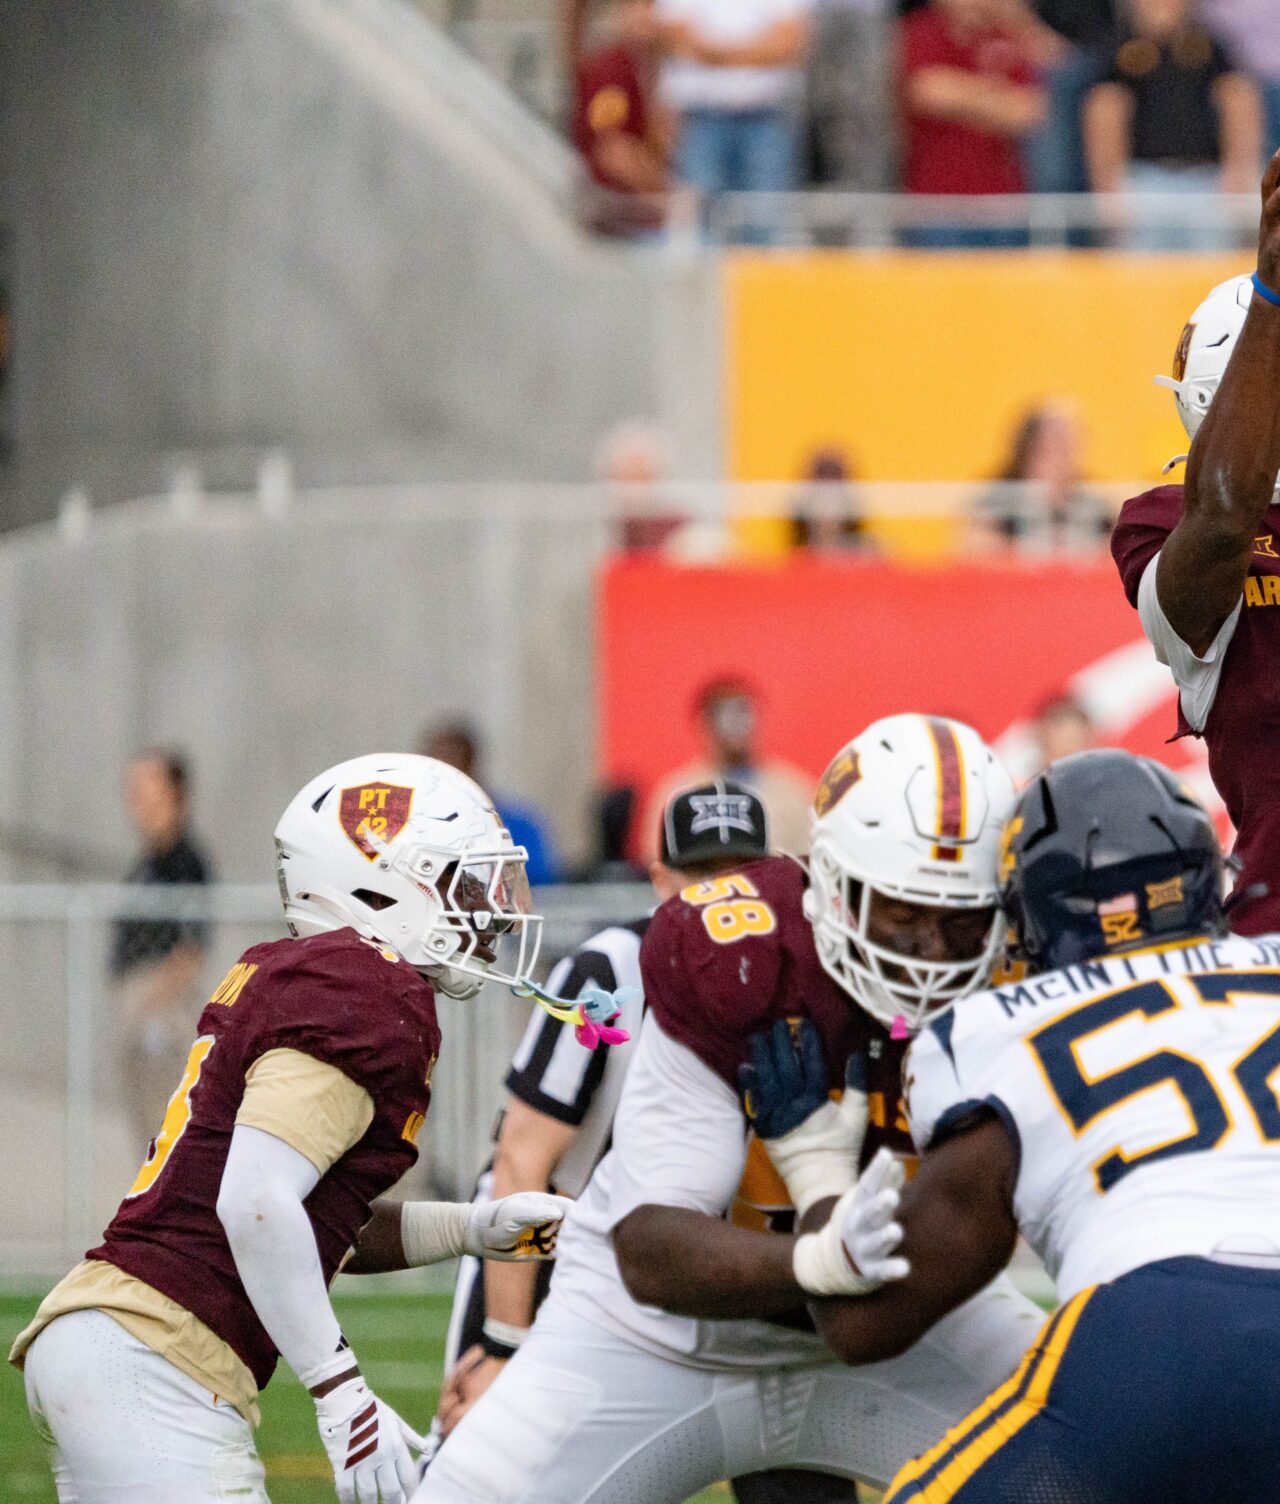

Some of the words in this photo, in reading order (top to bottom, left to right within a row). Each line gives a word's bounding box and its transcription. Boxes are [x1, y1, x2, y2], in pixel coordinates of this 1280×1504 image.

[358, 788, 391, 809] PT
[355, 816, 388, 841] 42
[680, 873, 777, 945] 58
[1101, 910, 1144, 945] 52
